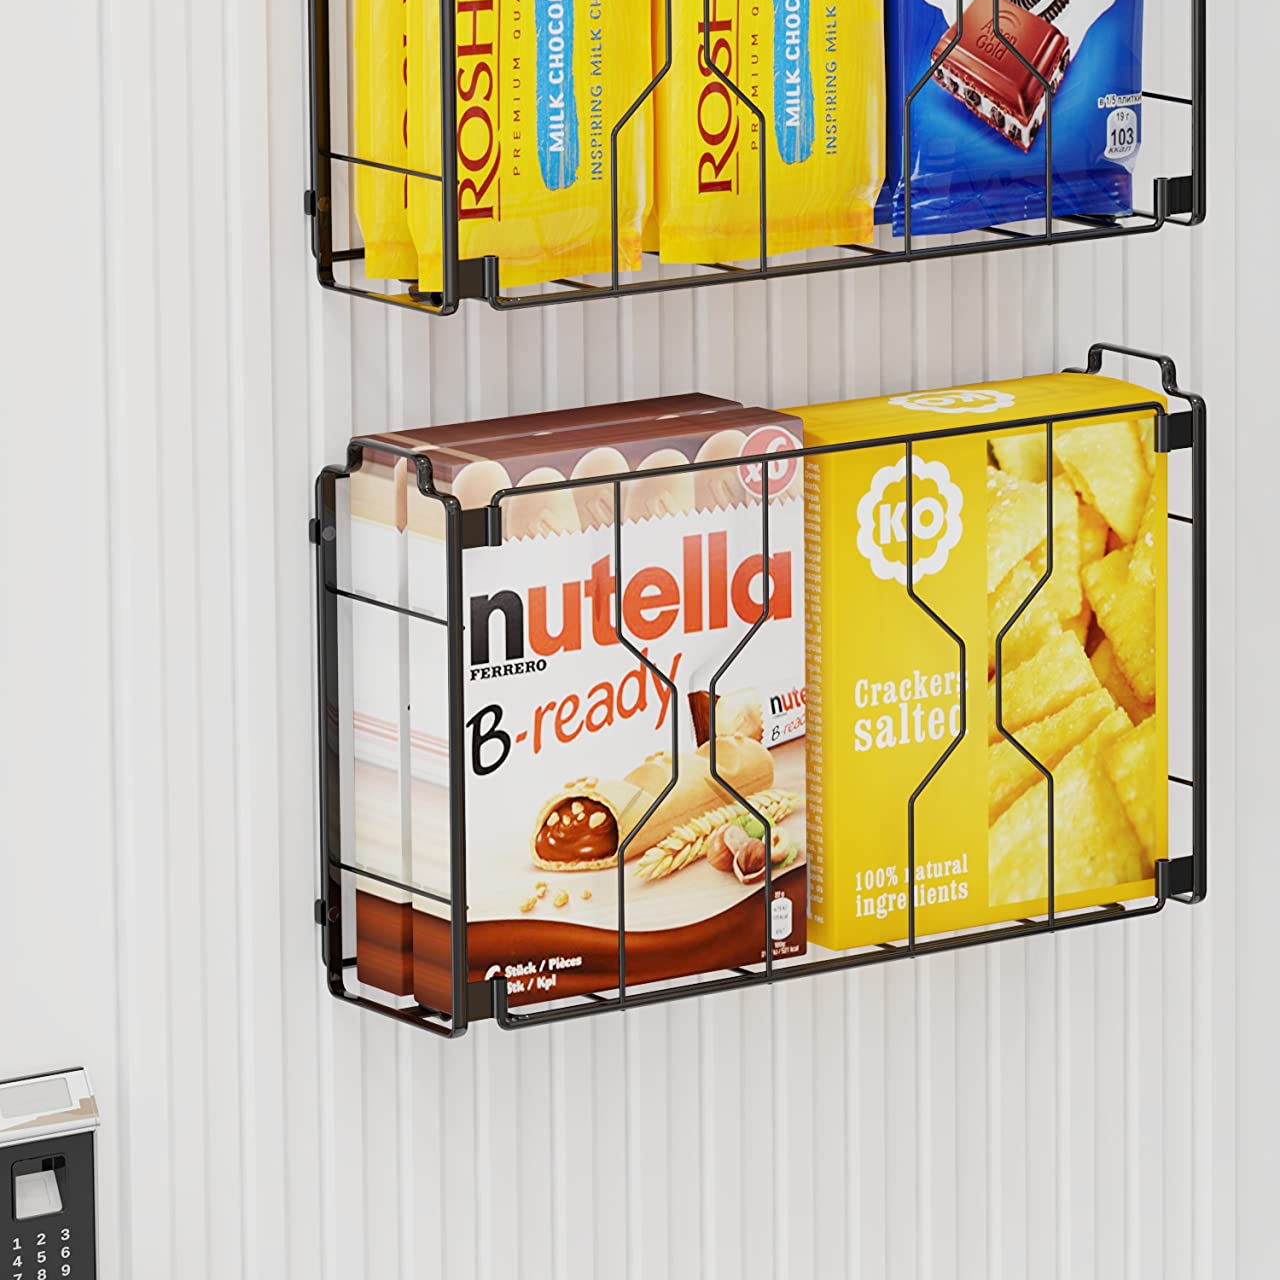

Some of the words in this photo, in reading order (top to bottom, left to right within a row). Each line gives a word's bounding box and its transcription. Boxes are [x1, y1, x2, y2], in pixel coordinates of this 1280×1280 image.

[976, 34, 1009, 60] Gold
[751, 34, 759, 151] PRMIUM
[784, 67, 801, 128] MILK
[512, 56, 521, 177] PREMIUM
[548, 89, 566, 154] MILK
[1116, 112, 1124, 121] 19
[1111, 128, 1134, 146] 103
[880, 497, 945, 545] KO
[470, 530, 792, 666] nutella
[470, 659, 547, 681] FERRERO
[466, 647, 683, 776] B-ready
[855, 865, 898, 891] 100%
[538, 960, 546, 972] /
[527, 978, 534, 991] /
[537, 974, 557, 991] Kpl
[12, 1238, 22, 1250] 1
[36, 1233, 46, 1246] 2
[60, 1228, 71, 1241] 3
[12, 1255, 23, 1267] 4
[37, 1250, 47, 1263] 5
[60, 1246, 71, 1259] 6
[37, 1268, 47, 1280] 8
[61, 1264, 71, 1277] 9
